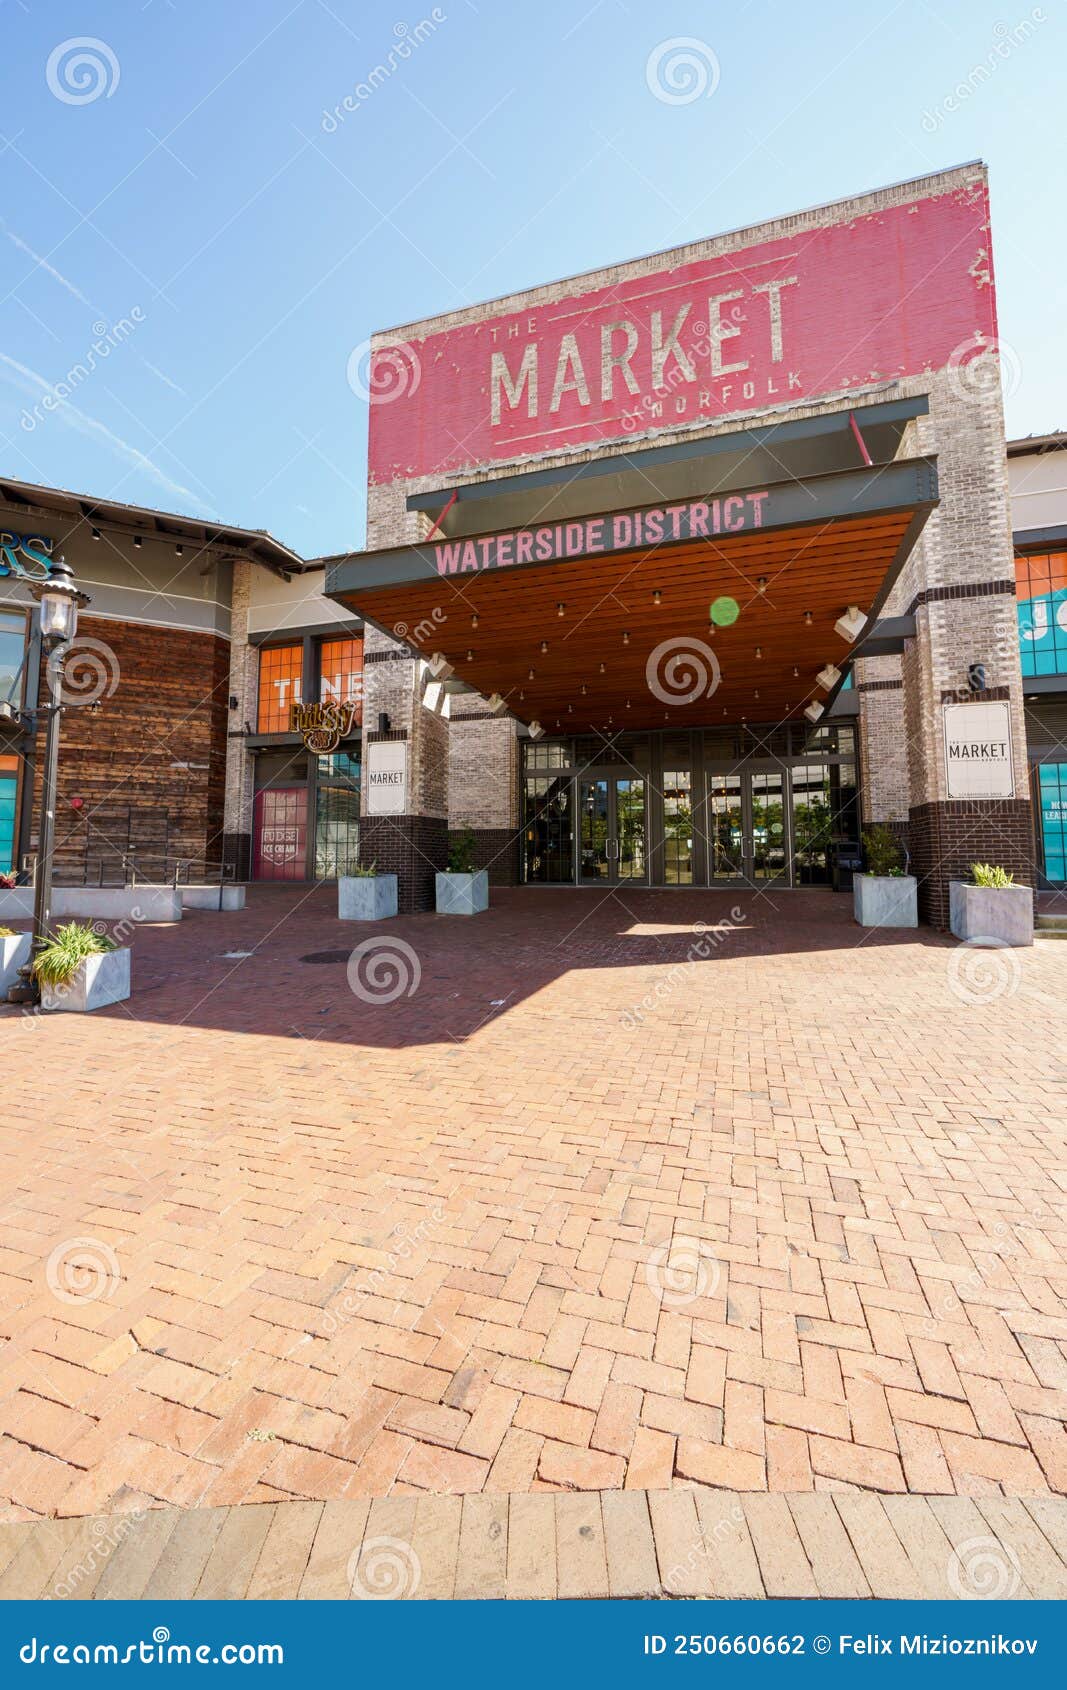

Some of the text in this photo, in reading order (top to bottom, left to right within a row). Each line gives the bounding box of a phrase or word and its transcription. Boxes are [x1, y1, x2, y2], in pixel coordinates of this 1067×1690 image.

[490, 317, 537, 343] THE
[491, 276, 798, 426] MARKET
[652, 370, 802, 418] NORFOLK
[435, 491, 769, 575] WATERSIDE DISTRICT
[949, 743, 1007, 758] MARKET
[370, 772, 404, 784] MARKET
[264, 831, 296, 842] FUDGE
[263, 844, 273, 853] ICE
